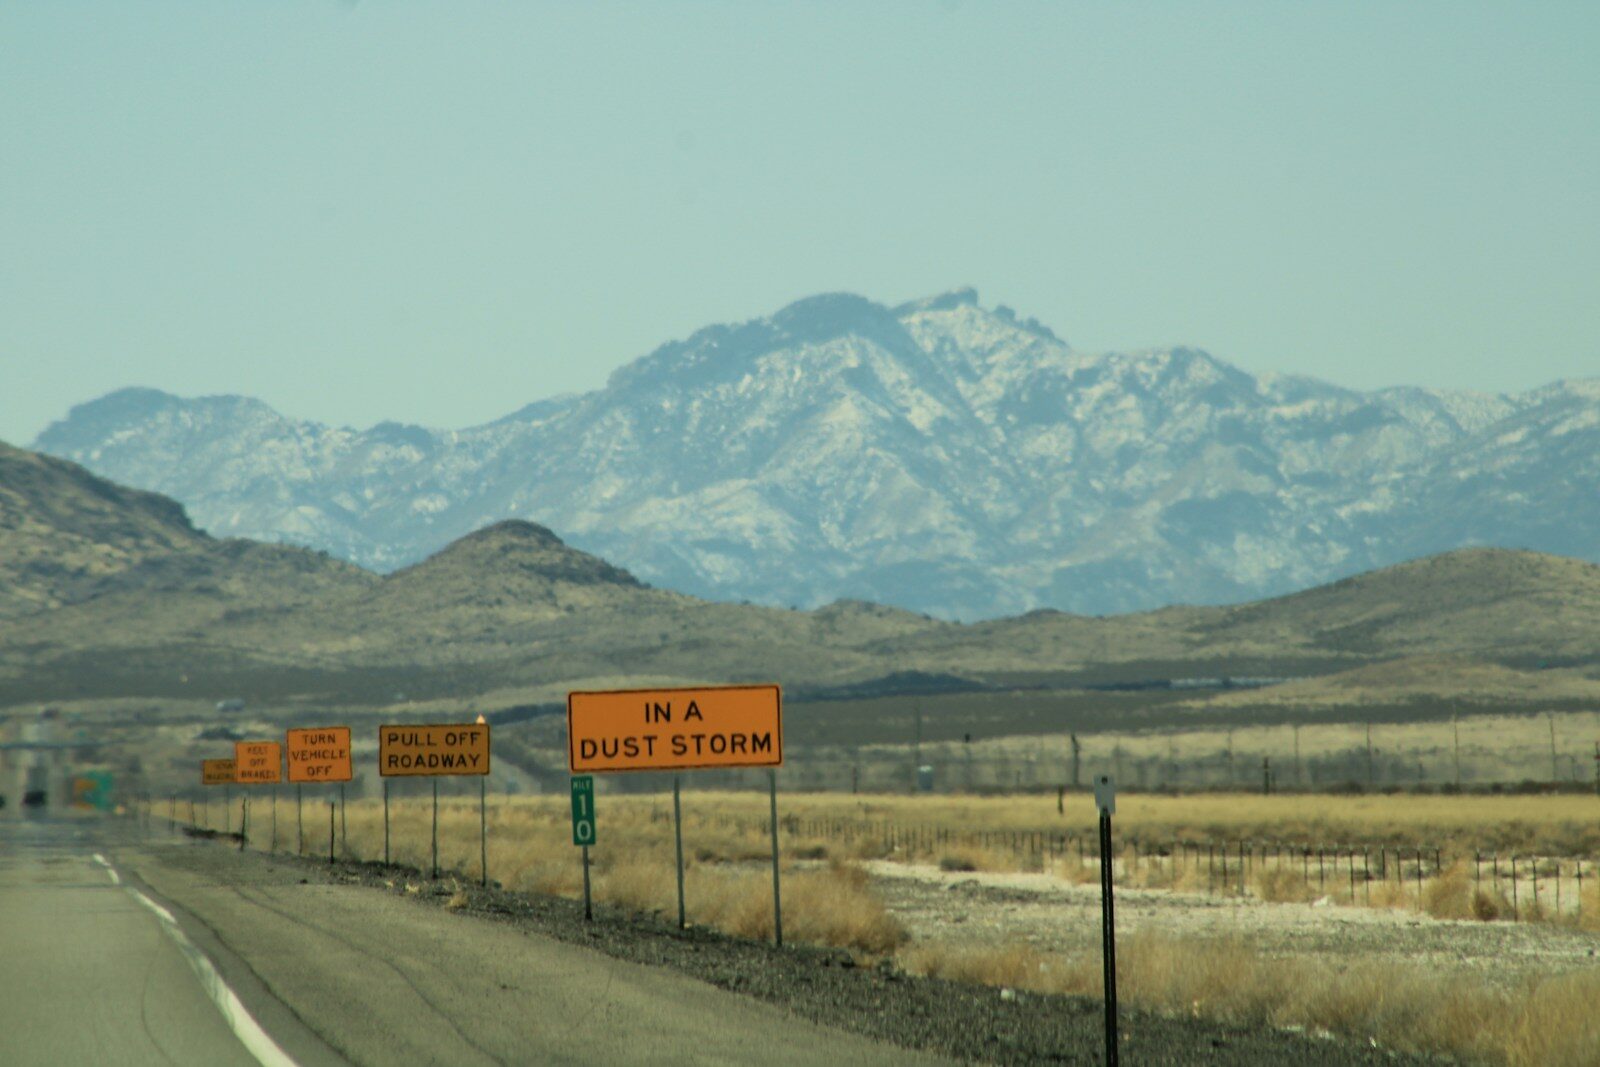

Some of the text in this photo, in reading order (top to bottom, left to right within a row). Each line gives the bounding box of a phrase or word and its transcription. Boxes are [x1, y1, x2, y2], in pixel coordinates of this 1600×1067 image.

[645, 700, 703, 723] IN A
[302, 734, 336, 745] TURN
[387, 732, 481, 747] PULL OFF
[581, 733, 771, 760] DUST STORM
[291, 750, 346, 761] VEHICLE
[387, 754, 480, 768] ROADWAY
[307, 765, 332, 776] OFF
